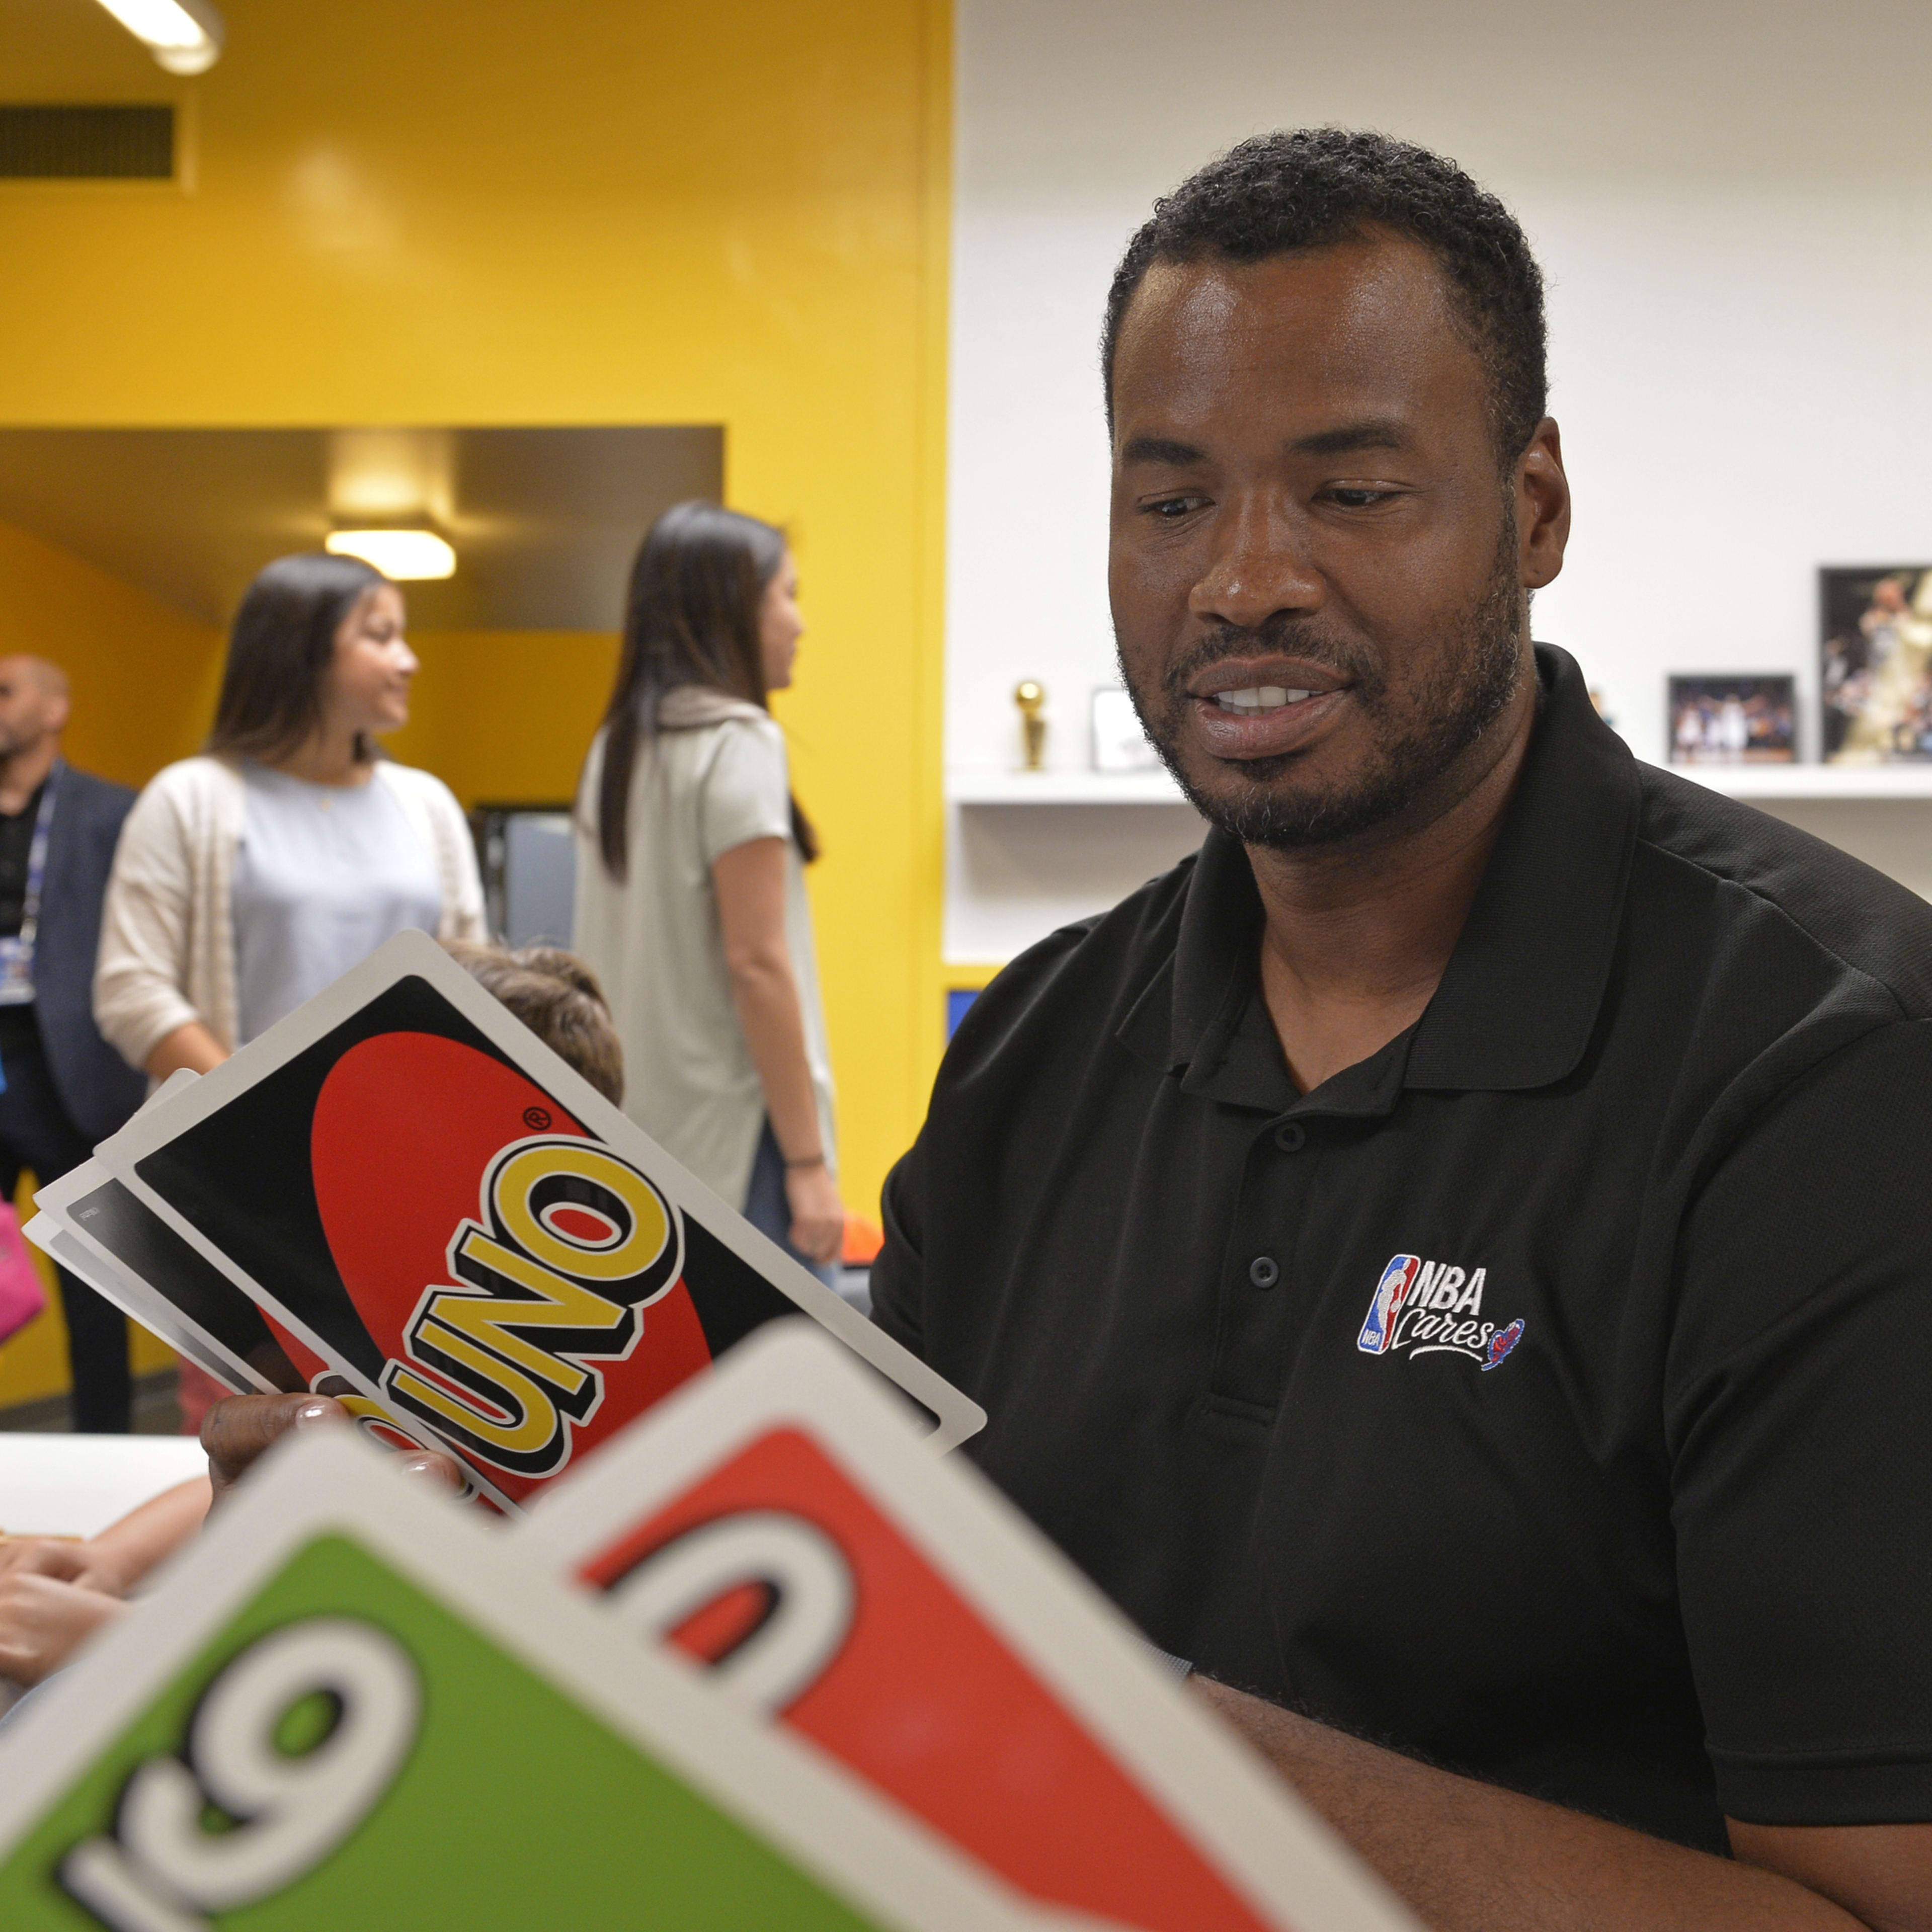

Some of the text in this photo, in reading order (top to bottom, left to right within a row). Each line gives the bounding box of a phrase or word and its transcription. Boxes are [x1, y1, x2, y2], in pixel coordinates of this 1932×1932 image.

[378, 1133, 685, 1479] UNO
[1407, 1261, 1486, 1315] NBA
[1361, 1329, 1381, 1346] NBA
[1392, 1308, 1494, 1350] Cares
[114, 1615, 424, 1913] 9
